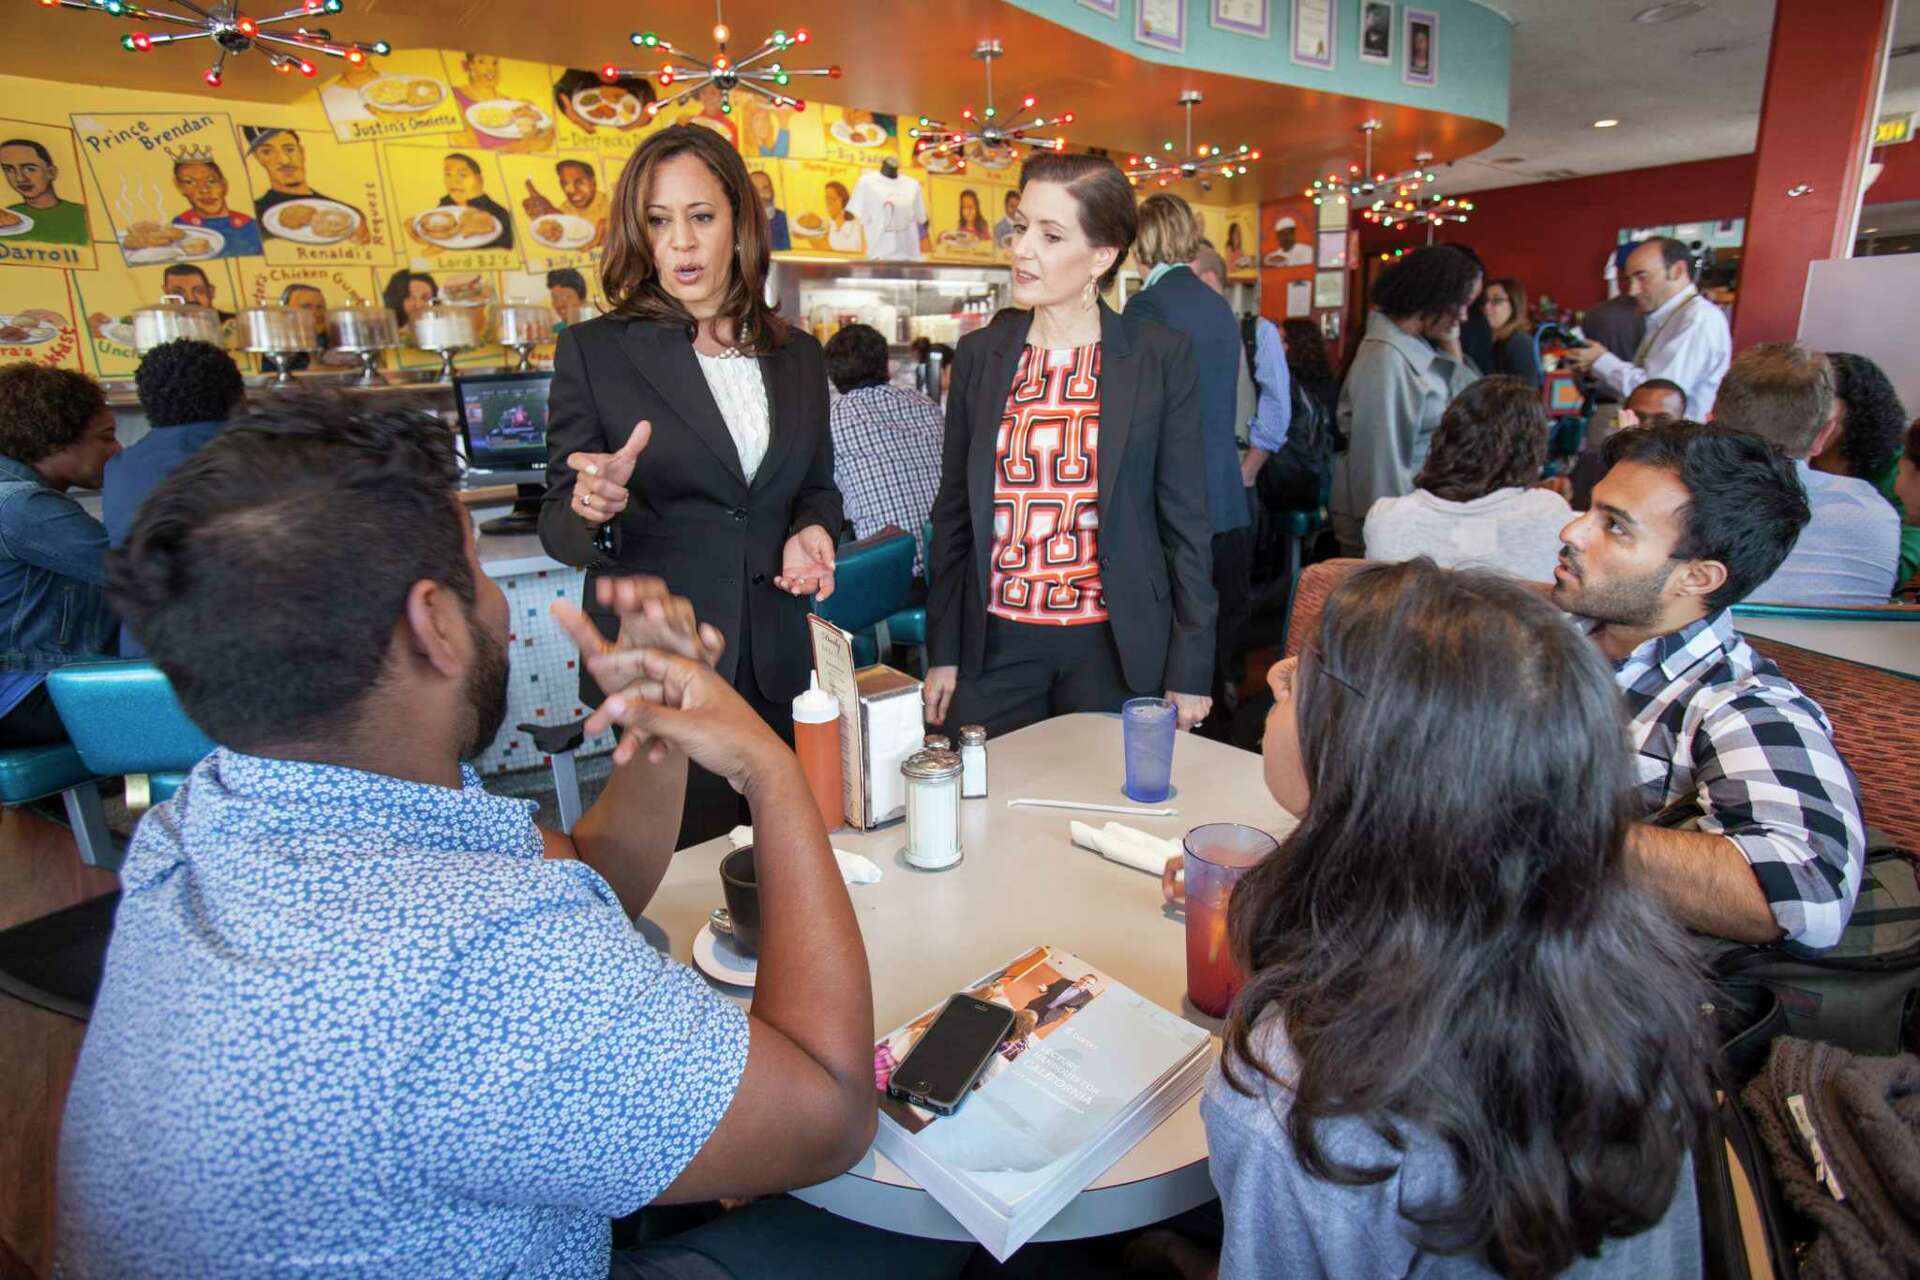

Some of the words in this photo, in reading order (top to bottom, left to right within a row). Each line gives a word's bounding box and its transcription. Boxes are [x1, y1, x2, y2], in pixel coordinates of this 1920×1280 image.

[86, 120, 150, 153] Prince
[137, 115, 215, 151] Brendan
[352, 119, 407, 138] Justin's
[1875, 121, 1907, 142] XIT
[364, 182, 384, 245] Request
[0, 242, 80, 263] Darroll
[438, 254, 472, 268] Lord
[270, 268, 328, 281] Chicken
[1023, 1059, 1093, 1105] CALIFORNIA
